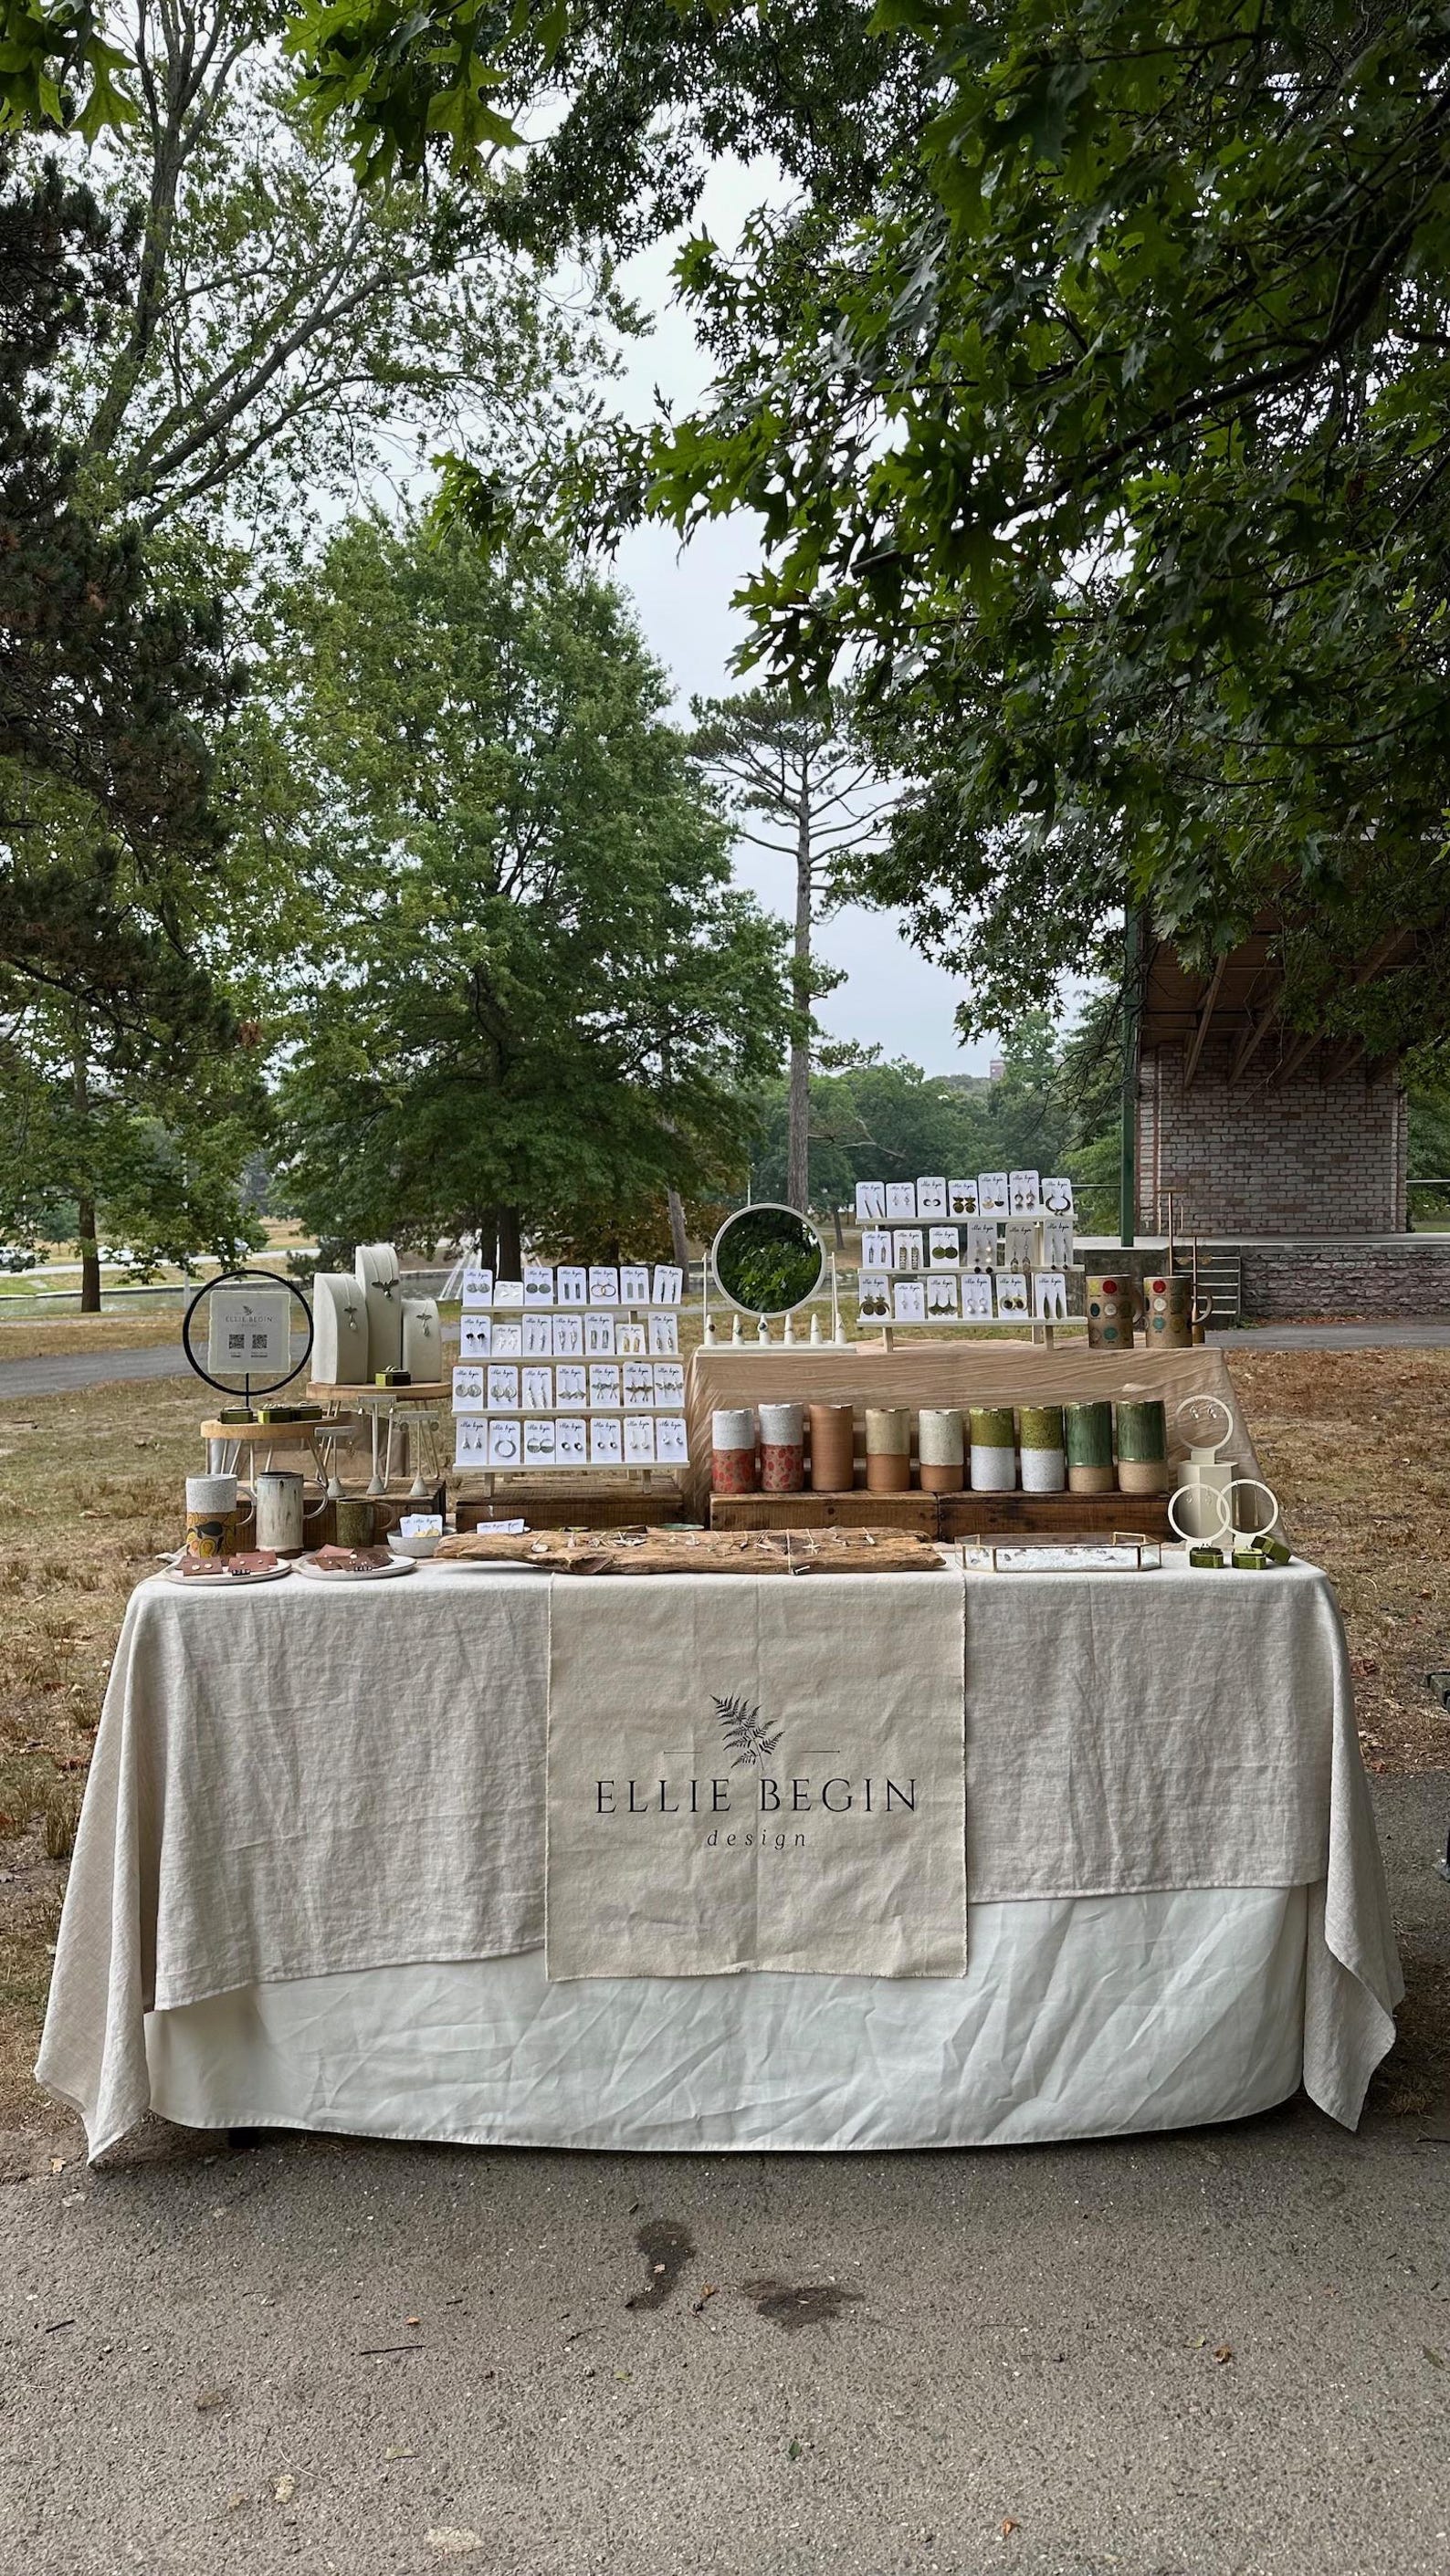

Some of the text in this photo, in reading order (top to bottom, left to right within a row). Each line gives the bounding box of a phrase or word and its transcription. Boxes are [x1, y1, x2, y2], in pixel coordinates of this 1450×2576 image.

[595, 1777, 918, 1814] ELLIE BEGIN
[707, 1828, 806, 1850] design
